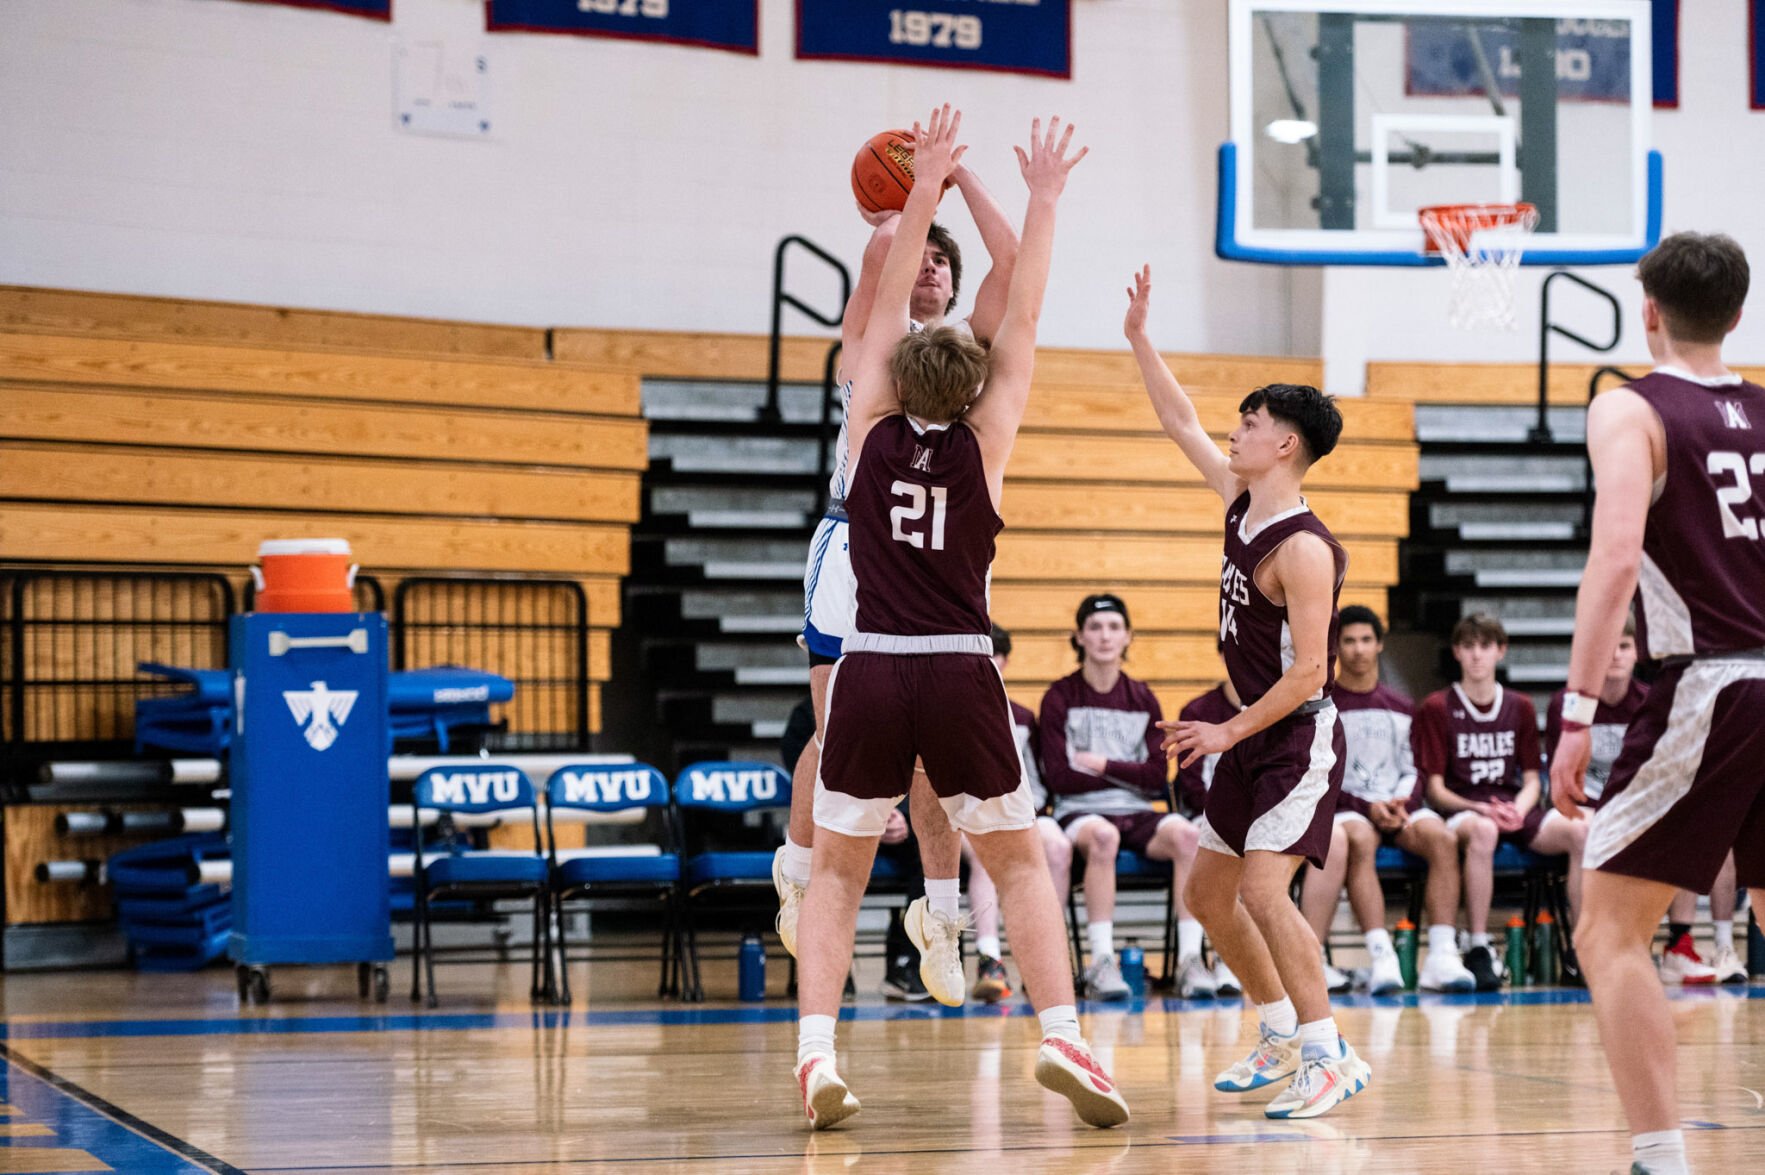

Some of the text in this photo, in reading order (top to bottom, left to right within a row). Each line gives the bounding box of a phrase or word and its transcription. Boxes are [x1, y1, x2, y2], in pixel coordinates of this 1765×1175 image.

[889, 9, 982, 50] 1979
[1499, 46, 1592, 81] 10
[890, 480, 948, 551] 21
[1219, 598, 1240, 646] 14
[1457, 730, 1515, 758] EAGLES
[430, 772, 520, 803] MVU
[563, 770, 651, 800] MVU
[691, 770, 777, 800] MVU
